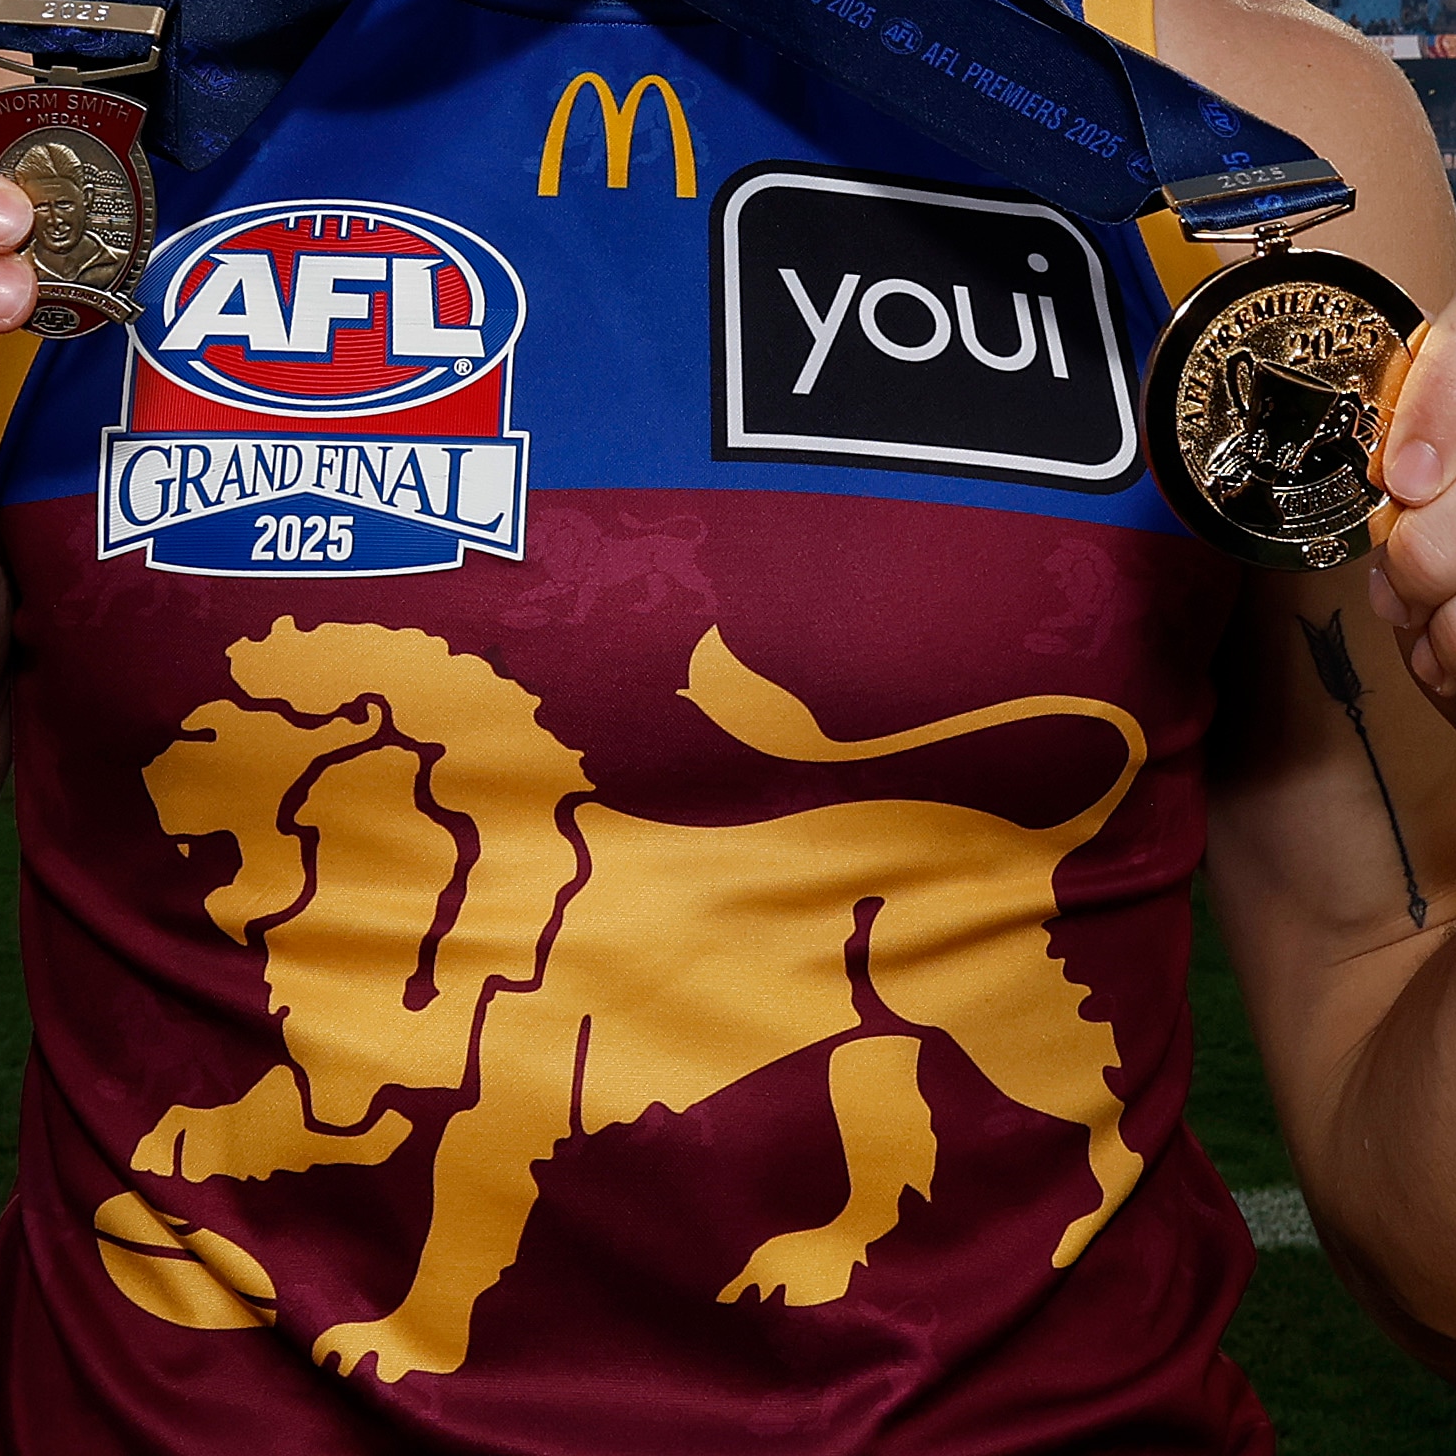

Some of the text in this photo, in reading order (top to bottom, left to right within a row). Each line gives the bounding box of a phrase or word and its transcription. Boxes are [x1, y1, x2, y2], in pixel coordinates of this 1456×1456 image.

[40, 2, 111, 22] 2025
[37, 112, 90, 128] MEDAL
[66, 94, 134, 124] SMITH
[920, 41, 962, 78] AFL
[960, 60, 1069, 131] PREMIERS
[1063, 116, 1127, 160] 2025
[1216, 166, 1287, 189] 2025
[32, 310, 77, 328] AFL
[159, 252, 485, 359] AFL
[777, 252, 1070, 394] youi
[1287, 318, 1380, 367] 2025
[120, 442, 503, 534] GRAND FINAL
[251, 514, 355, 562] 2025
